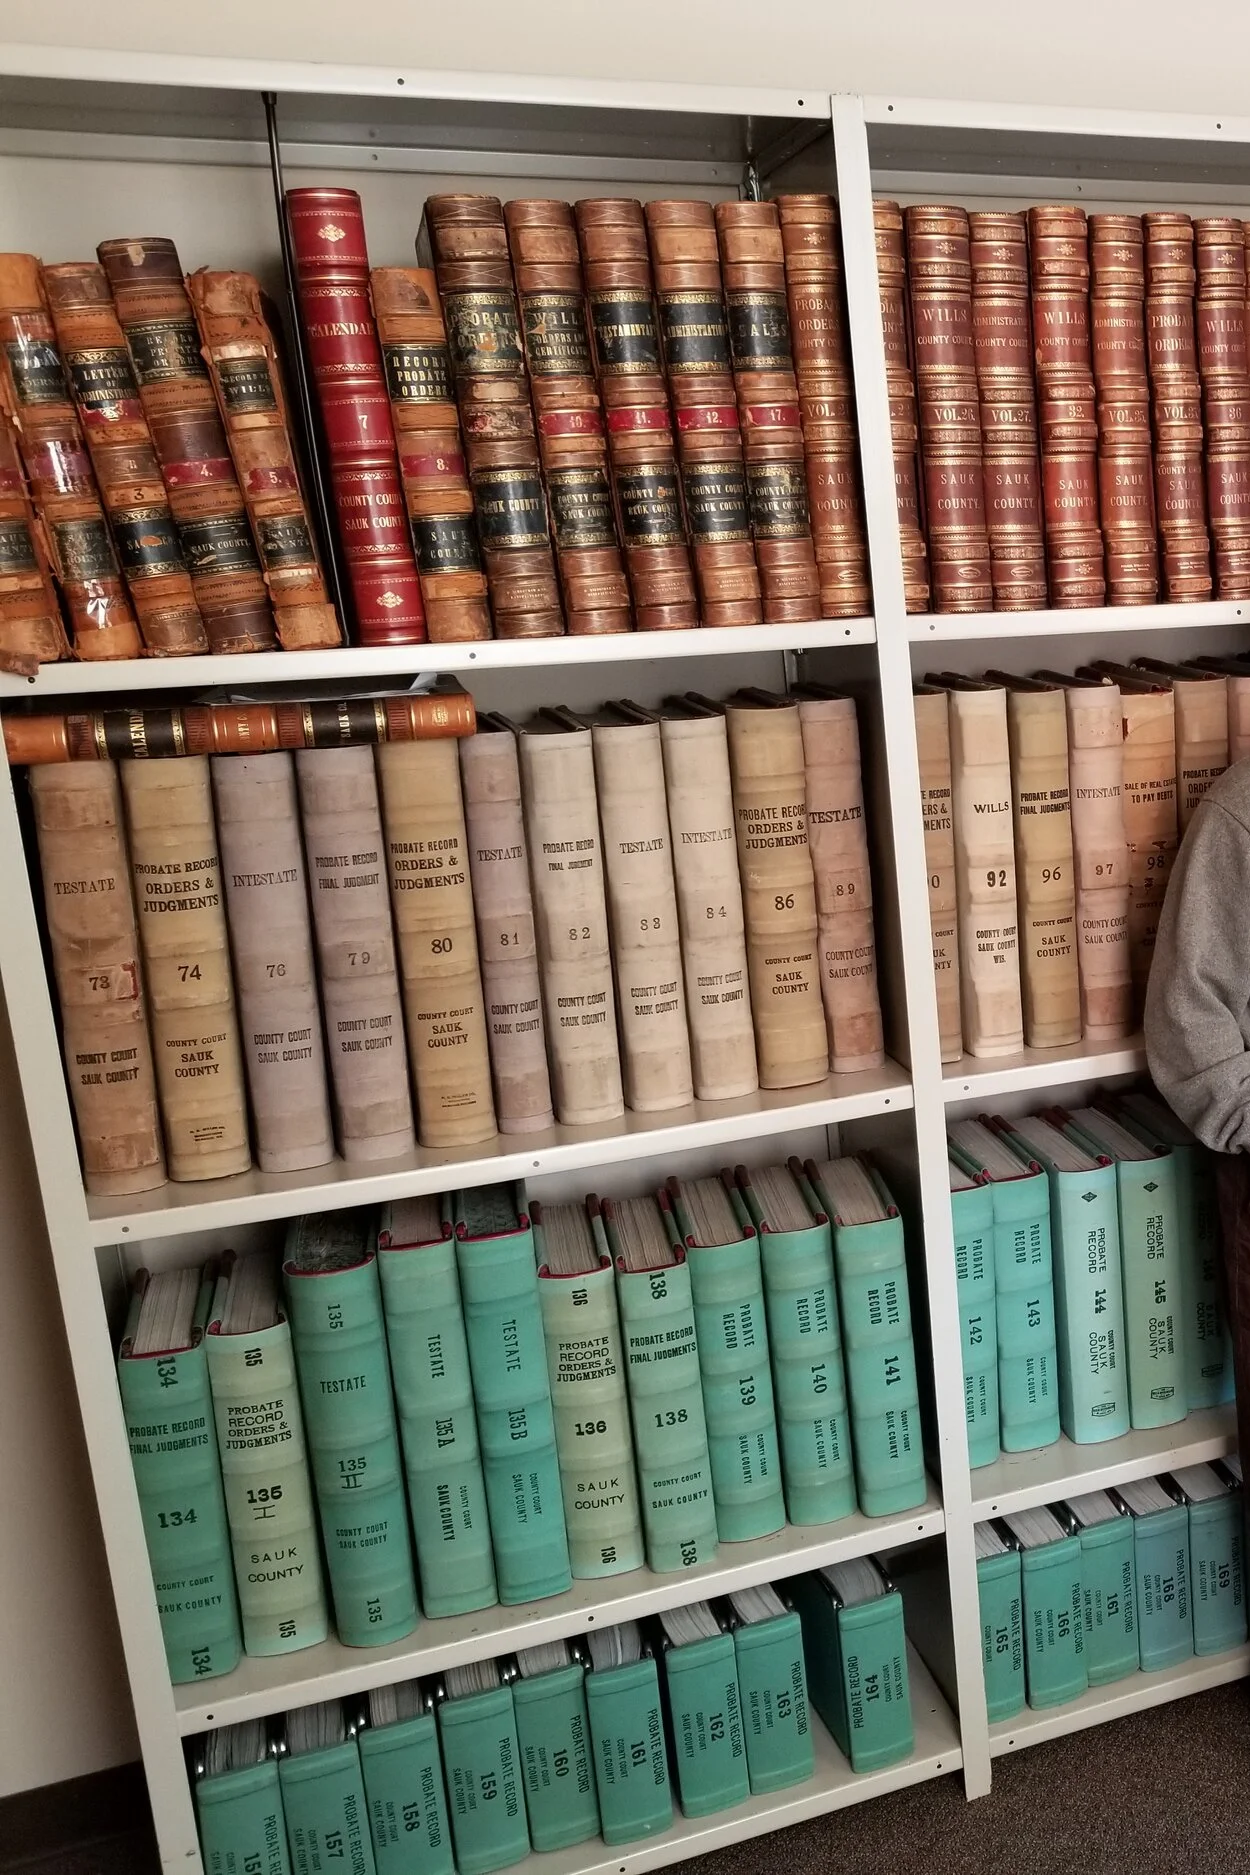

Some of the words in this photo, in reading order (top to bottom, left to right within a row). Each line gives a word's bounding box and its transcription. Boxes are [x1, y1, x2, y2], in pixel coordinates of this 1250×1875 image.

[922, 308, 968, 322] WILLS
[634, 409, 652, 424] 11.
[706, 410, 723, 425] 12.
[1068, 405, 1085, 418] 32.
[1228, 408, 1242, 420] 36
[357, 414, 369, 430] 7
[436, 458, 450, 472] 8.
[269, 471, 283, 484] 5.
[940, 473, 975, 485] SAUK
[1020, 790, 1048, 803] PROBATE
[1050, 788, 1069, 802] RECORD
[809, 805, 863, 825] TESTATE
[973, 801, 1010, 815] WILLS
[1020, 804, 1037, 816] FINAL
[1039, 801, 1071, 814] JUDGMENTS
[681, 827, 733, 844] INTESTATE
[747, 822, 793, 835] ORDERS
[796, 819, 805, 831] &
[390, 840, 425, 854] PROBATE
[427, 838, 458, 852] RECORD
[619, 838, 664, 854] TESTATE
[745, 833, 808, 850] JUDGMENTS
[477, 846, 523, 861] TESTATE
[134, 862, 182, 876] PROBATE
[394, 856, 444, 871] ORDERS
[448, 855, 459, 868] &
[1095, 863, 1114, 876] 97
[232, 869, 298, 888] INTESTATE
[392, 872, 465, 891] JUDGMENTS
[986, 870, 1007, 888] 92
[1041, 866, 1062, 883] 96
[54, 879, 115, 896] TESTATE
[145, 879, 200, 896] ORDERS
[204, 877, 214, 890] &
[835, 883, 856, 897] 89
[143, 895, 220, 913] JUDGMENTS
[774, 894, 795, 911] 86
[706, 905, 727, 919] 84
[500, 932, 520, 946] 81
[568, 926, 591, 941] 82
[1041, 934, 1066, 946] SAUK
[430, 937, 454, 954] 80
[1036, 945, 1071, 958] COUNTY
[347, 951, 371, 967] 79
[177, 964, 202, 983] 74
[266, 964, 286, 978] 76
[775, 970, 803, 982] SAUK
[89, 975, 111, 991] 73
[771, 982, 810, 996] COUNTY
[432, 1023, 462, 1035] SAUK
[427, 1034, 470, 1048] COUNTY
[180, 1049, 214, 1063] SAUK
[174, 1064, 220, 1078] COUNTY
[1088, 1230, 1097, 1274] RECORD
[1098, 1226, 1107, 1273] PROBATE
[1154, 1280, 1166, 1305] 145
[1094, 1289, 1107, 1315] 144
[1026, 1299, 1041, 1328] 143
[722, 1312, 738, 1350] RECORD
[740, 1303, 756, 1349] PROBATE
[968, 1316, 983, 1346] 142
[558, 1336, 609, 1352] PROBATE
[1097, 1335, 1107, 1369] SAUK
[427, 1334, 445, 1379] TESTATE
[559, 1347, 609, 1362] RECORD
[629, 1350, 651, 1365] FINAL
[653, 1342, 697, 1361] JUDGMENTS
[1088, 1331, 1099, 1375] COUNTY
[556, 1365, 617, 1383] JUDGMENTS
[811, 1363, 828, 1394] 140
[884, 1356, 901, 1386] 141
[320, 1375, 366, 1395] TESTATE
[739, 1375, 757, 1407] 139
[227, 1399, 284, 1416] PROBATE
[229, 1411, 284, 1427] RECORD
[654, 1409, 688, 1429] 138
[228, 1423, 276, 1437] ORDERS
[279, 1420, 289, 1431] &
[574, 1421, 608, 1437] 136
[225, 1430, 293, 1450] JUDGMENTS
[338, 1458, 367, 1473] 135
[577, 1478, 619, 1493] SAUK
[246, 1486, 284, 1504] 135
[574, 1494, 625, 1511] COUNTY
[157, 1508, 198, 1529] 134
[250, 1548, 298, 1564] SAUK
[247, 1565, 305, 1583] COUNTY
[1218, 1562, 1230, 1589] 169
[1162, 1575, 1175, 1603] 168
[1057, 1610, 1070, 1638] 166
[995, 1625, 1009, 1654] 165
[864, 1674, 880, 1703] 164
[776, 1690, 792, 1720] 163
[709, 1712, 725, 1742] 162
[630, 1740, 647, 1768] 161
[552, 1748, 570, 1778] 160
[420, 1766, 435, 1809] PROBATE
[479, 1771, 498, 1801] 159
[402, 1801, 421, 1833] 158
[427, 1809, 442, 1849] RECORD
